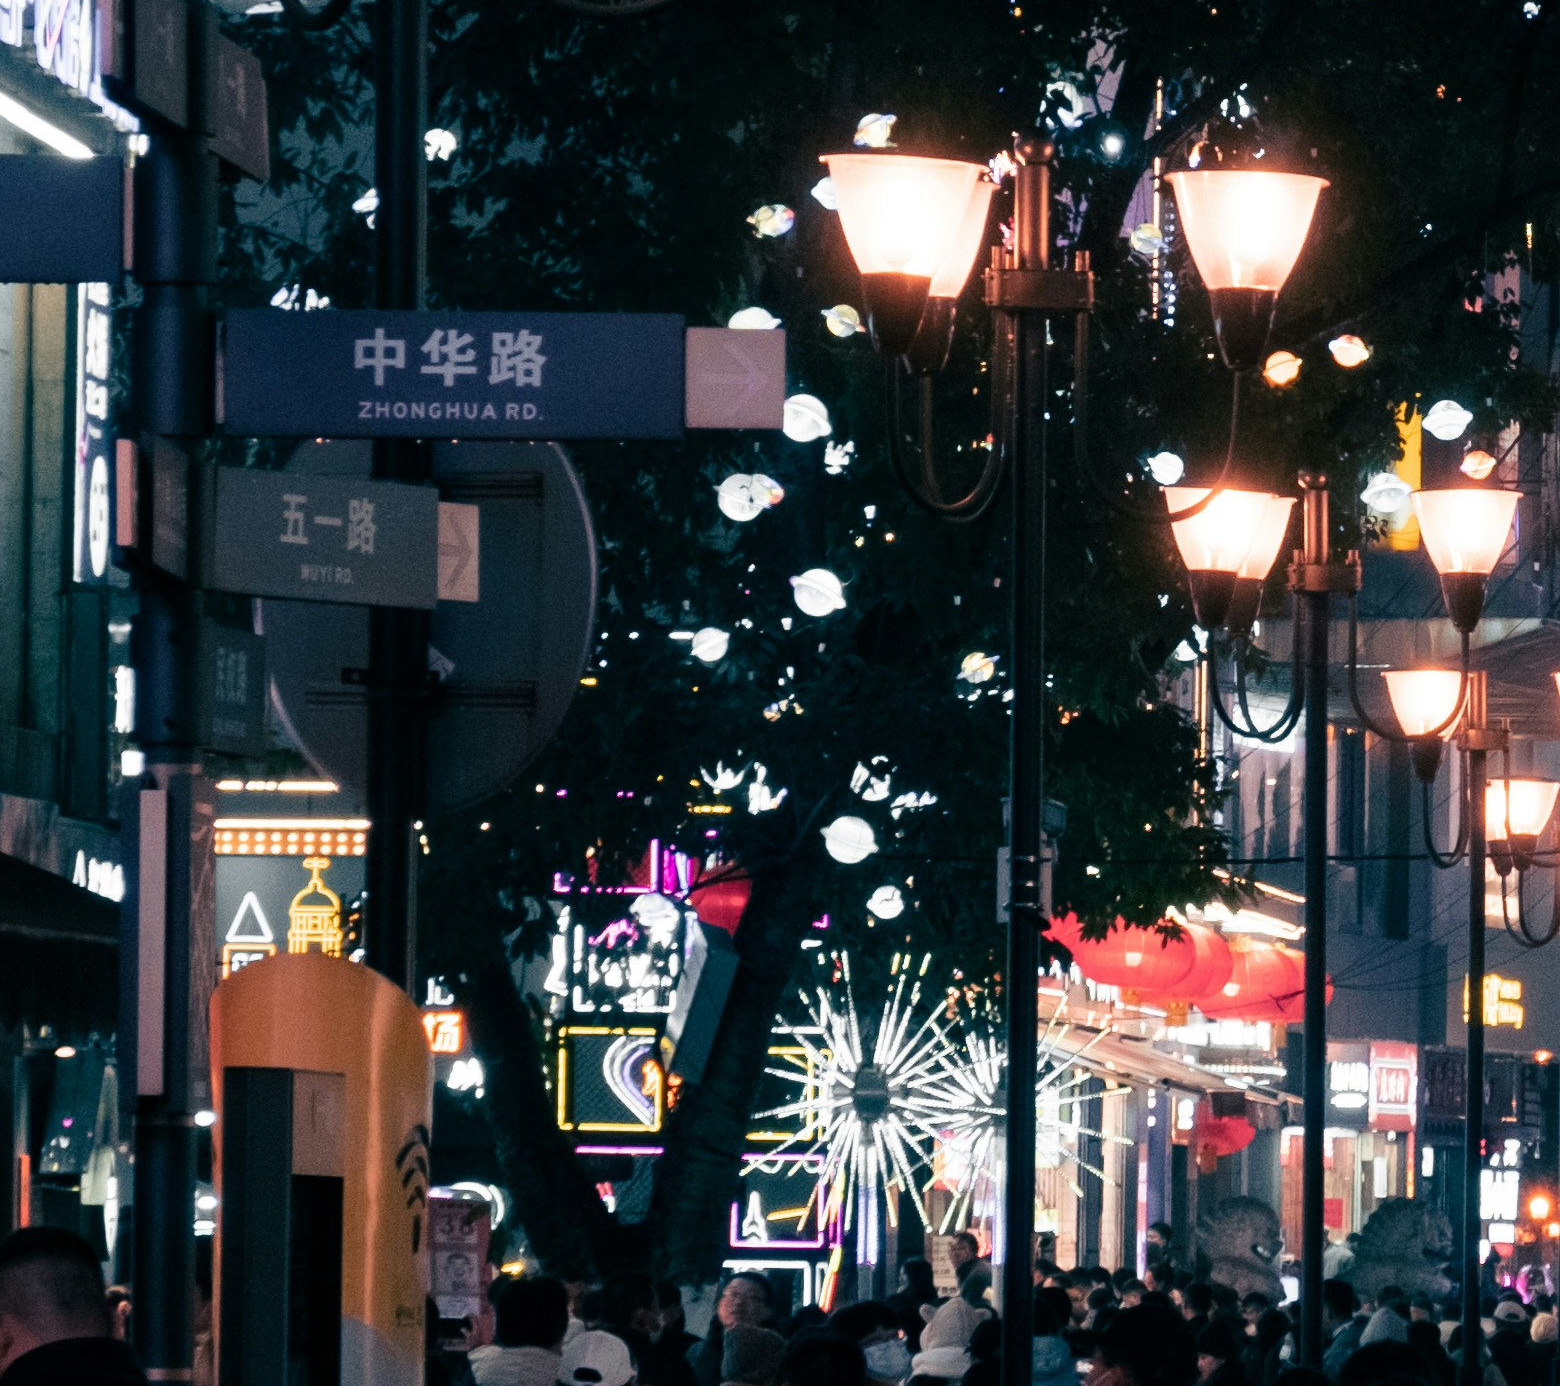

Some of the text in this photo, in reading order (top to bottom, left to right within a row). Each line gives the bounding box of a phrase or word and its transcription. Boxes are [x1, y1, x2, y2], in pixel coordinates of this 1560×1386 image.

[354, 328, 547, 388] 中华路
[358, 401, 544, 422] ZHONGHUA RD.
[280, 493, 378, 555] 五一路
[300, 564, 331, 582] WUYI
